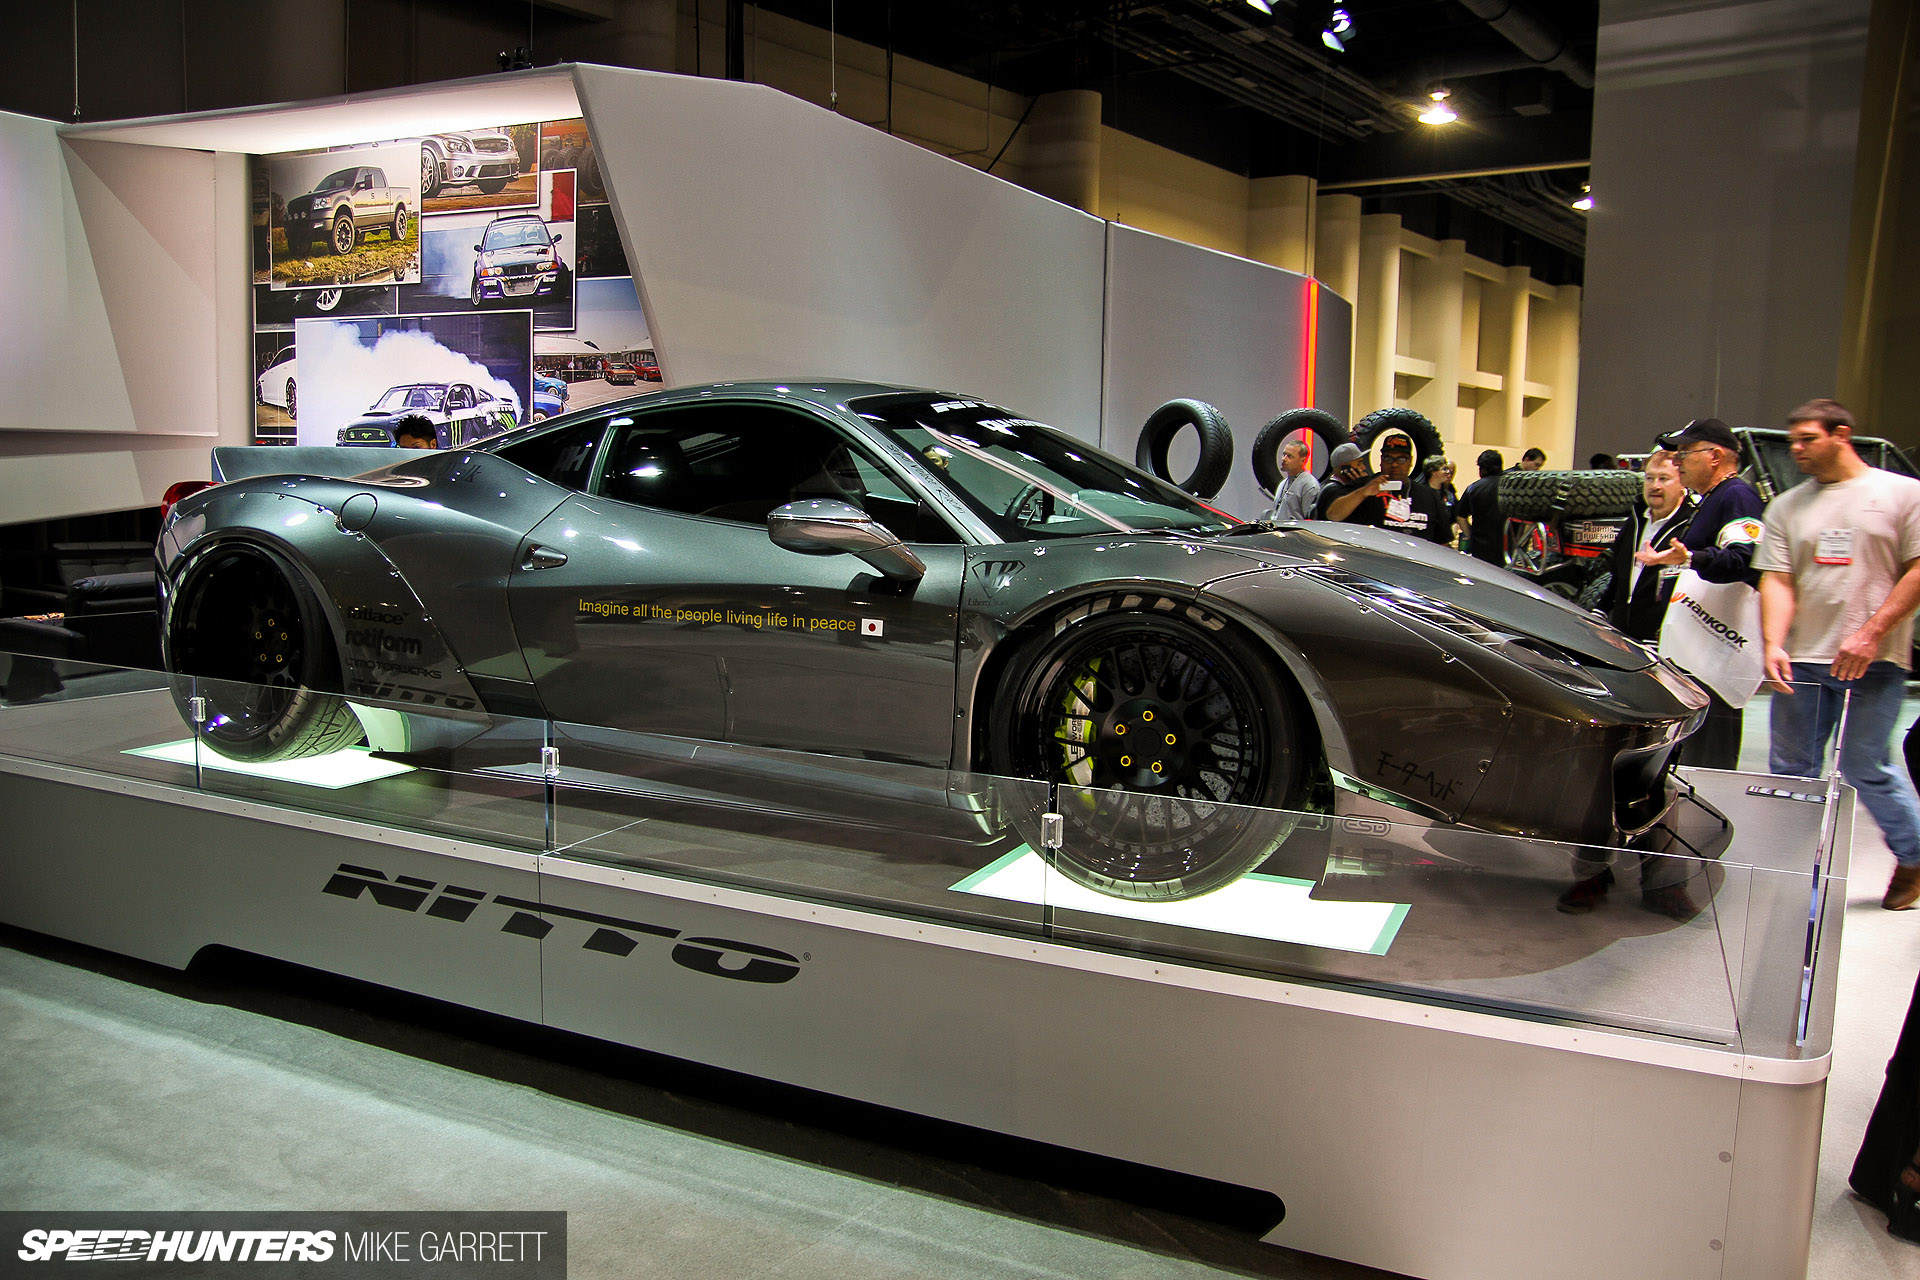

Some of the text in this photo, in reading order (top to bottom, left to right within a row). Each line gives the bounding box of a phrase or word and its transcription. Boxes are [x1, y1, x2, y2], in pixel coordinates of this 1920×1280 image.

[579, 598, 857, 632] Imagine all the people living life in peace
[321, 863, 801, 984] NITTO
